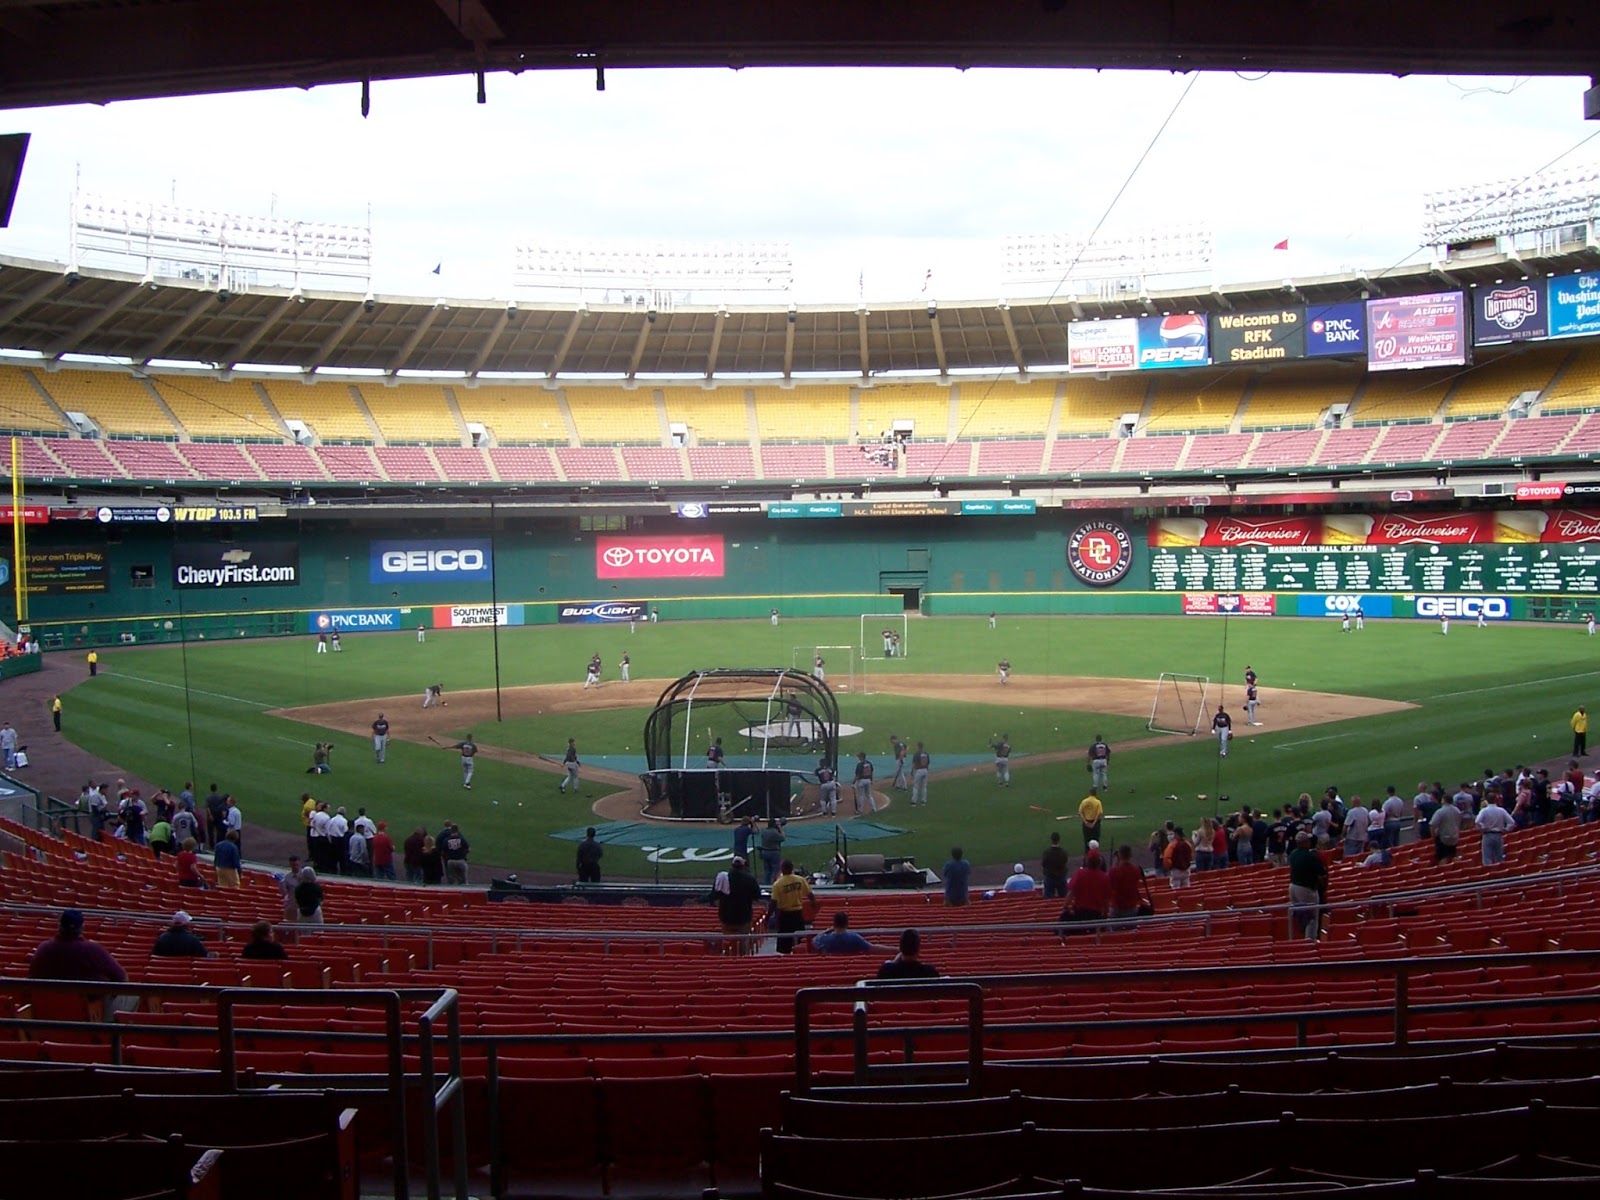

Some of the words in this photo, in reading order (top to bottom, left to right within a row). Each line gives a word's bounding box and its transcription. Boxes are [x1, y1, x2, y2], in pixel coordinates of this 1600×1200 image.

[1579, 276, 1598, 289] The
[1413, 306, 1455, 316] Atlanta
[1488, 294, 1534, 317] NATIONALS
[1219, 314, 1280, 329] Welcome
[1282, 311, 1297, 323] to
[1325, 319, 1352, 331] PNC
[1244, 329, 1272, 343] RFK
[1325, 329, 1360, 342] BANK
[1408, 334, 1455, 344] Washington
[1099, 346, 1122, 354] LONG
[1140, 346, 1206, 364] PEPSI
[1230, 345, 1285, 360] Stadium
[1399, 343, 1453, 355] NATIONALS
[1529, 487, 1561, 495] TOYOTA
[174, 507, 217, 520] WTOP
[218, 508, 241, 520] 103.5
[243, 508, 256, 519] FM
[1071, 522, 1128, 548] WASHINGTON
[1219, 526, 1301, 541] Budweiser
[1384, 524, 1469, 539] Budweiser
[1268, 545, 1317, 553] WASHINGTON
[1319, 545, 1339, 553] HALL
[1353, 545, 1377, 553] STARS
[65, 553, 85, 561] Triple
[382, 549, 484, 572] GEICO
[634, 548, 715, 564] TOYOTA
[177, 565, 295, 587] ChevyFirst.com
[1073, 559, 1126, 580] NATIONALS
[453, 607, 505, 617] SOUTHWEST
[562, 608, 593, 616] BUD
[599, 607, 641, 615] LIGHT
[1417, 597, 1506, 617] GEICO
[331, 614, 357, 626] PNC
[358, 613, 393, 626] BANK
[461, 615, 498, 624] AIRLINES
